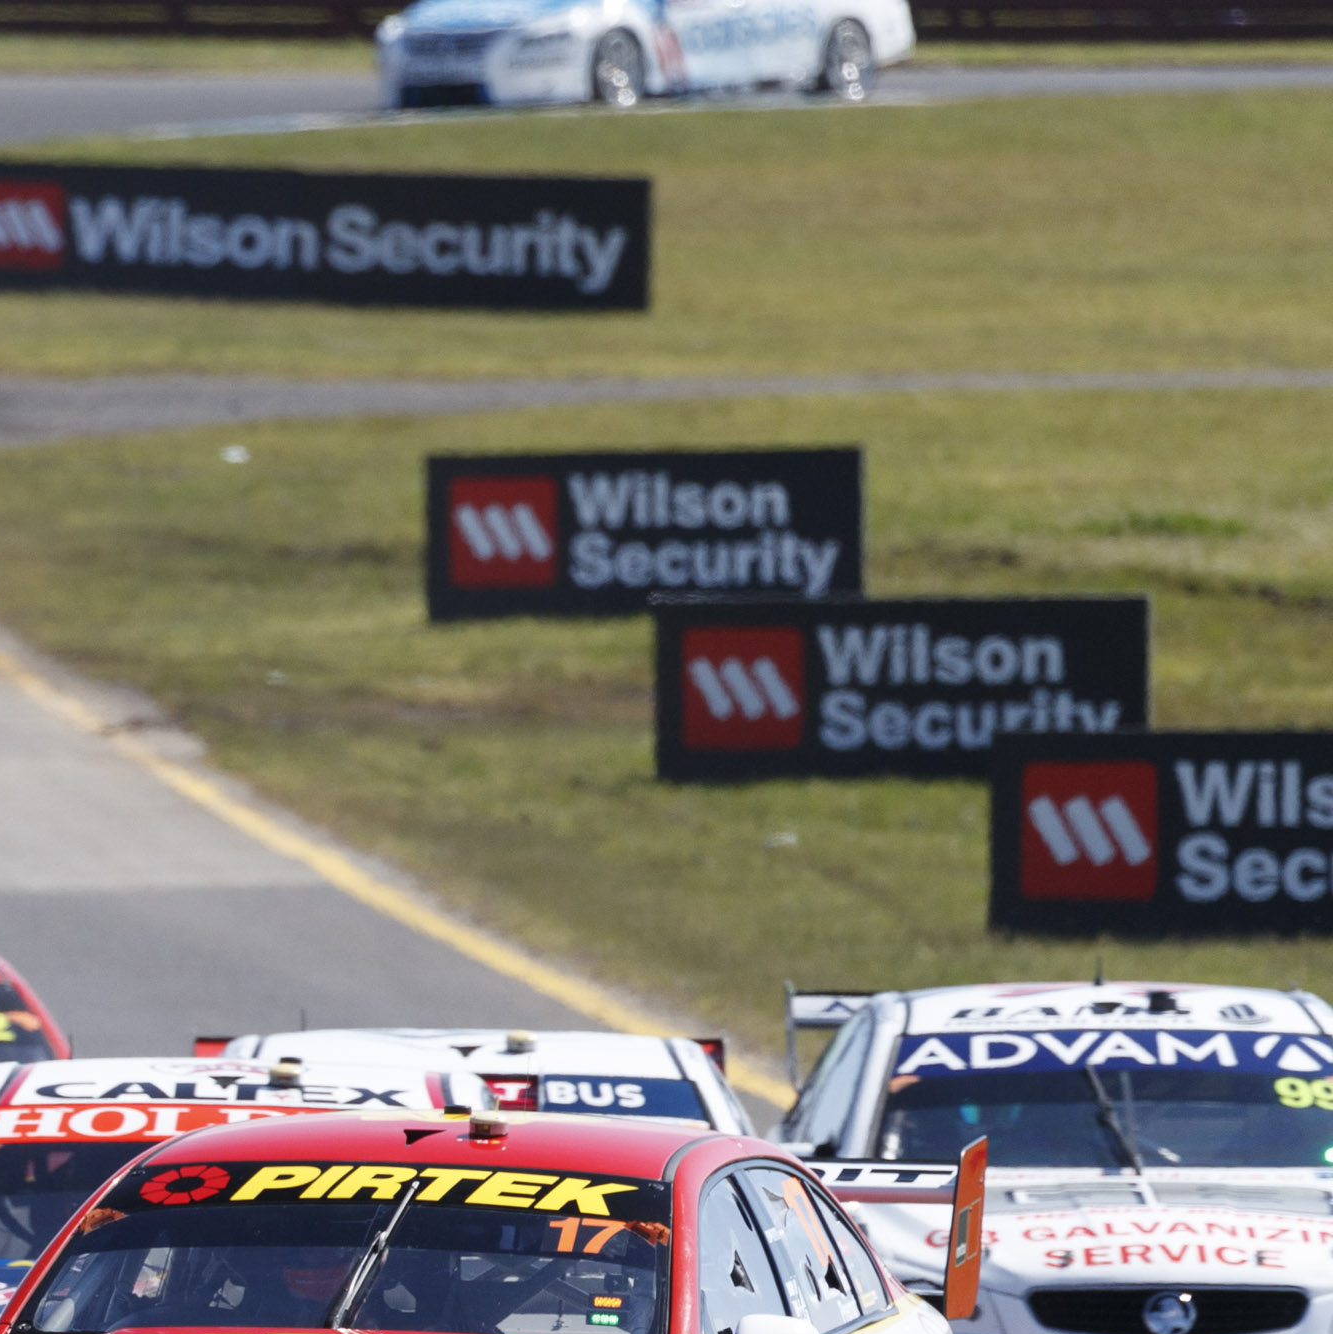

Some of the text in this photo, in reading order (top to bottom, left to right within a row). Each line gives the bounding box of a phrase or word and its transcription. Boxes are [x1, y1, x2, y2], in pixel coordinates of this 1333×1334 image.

[68, 192, 626, 294] Wilson Security
[568, 472, 791, 528] Wilson
[569, 535, 839, 598] Security
[817, 624, 1065, 685] Wilson
[1176, 833, 1333, 903] Sec
[897, 1031, 1240, 1073] ADVAM
[544, 1079, 647, 1109] BUS
[229, 1163, 641, 1217] PIRTEK
[547, 1216, 628, 1255] 17
[1044, 1243, 1288, 1270] SERVICE
